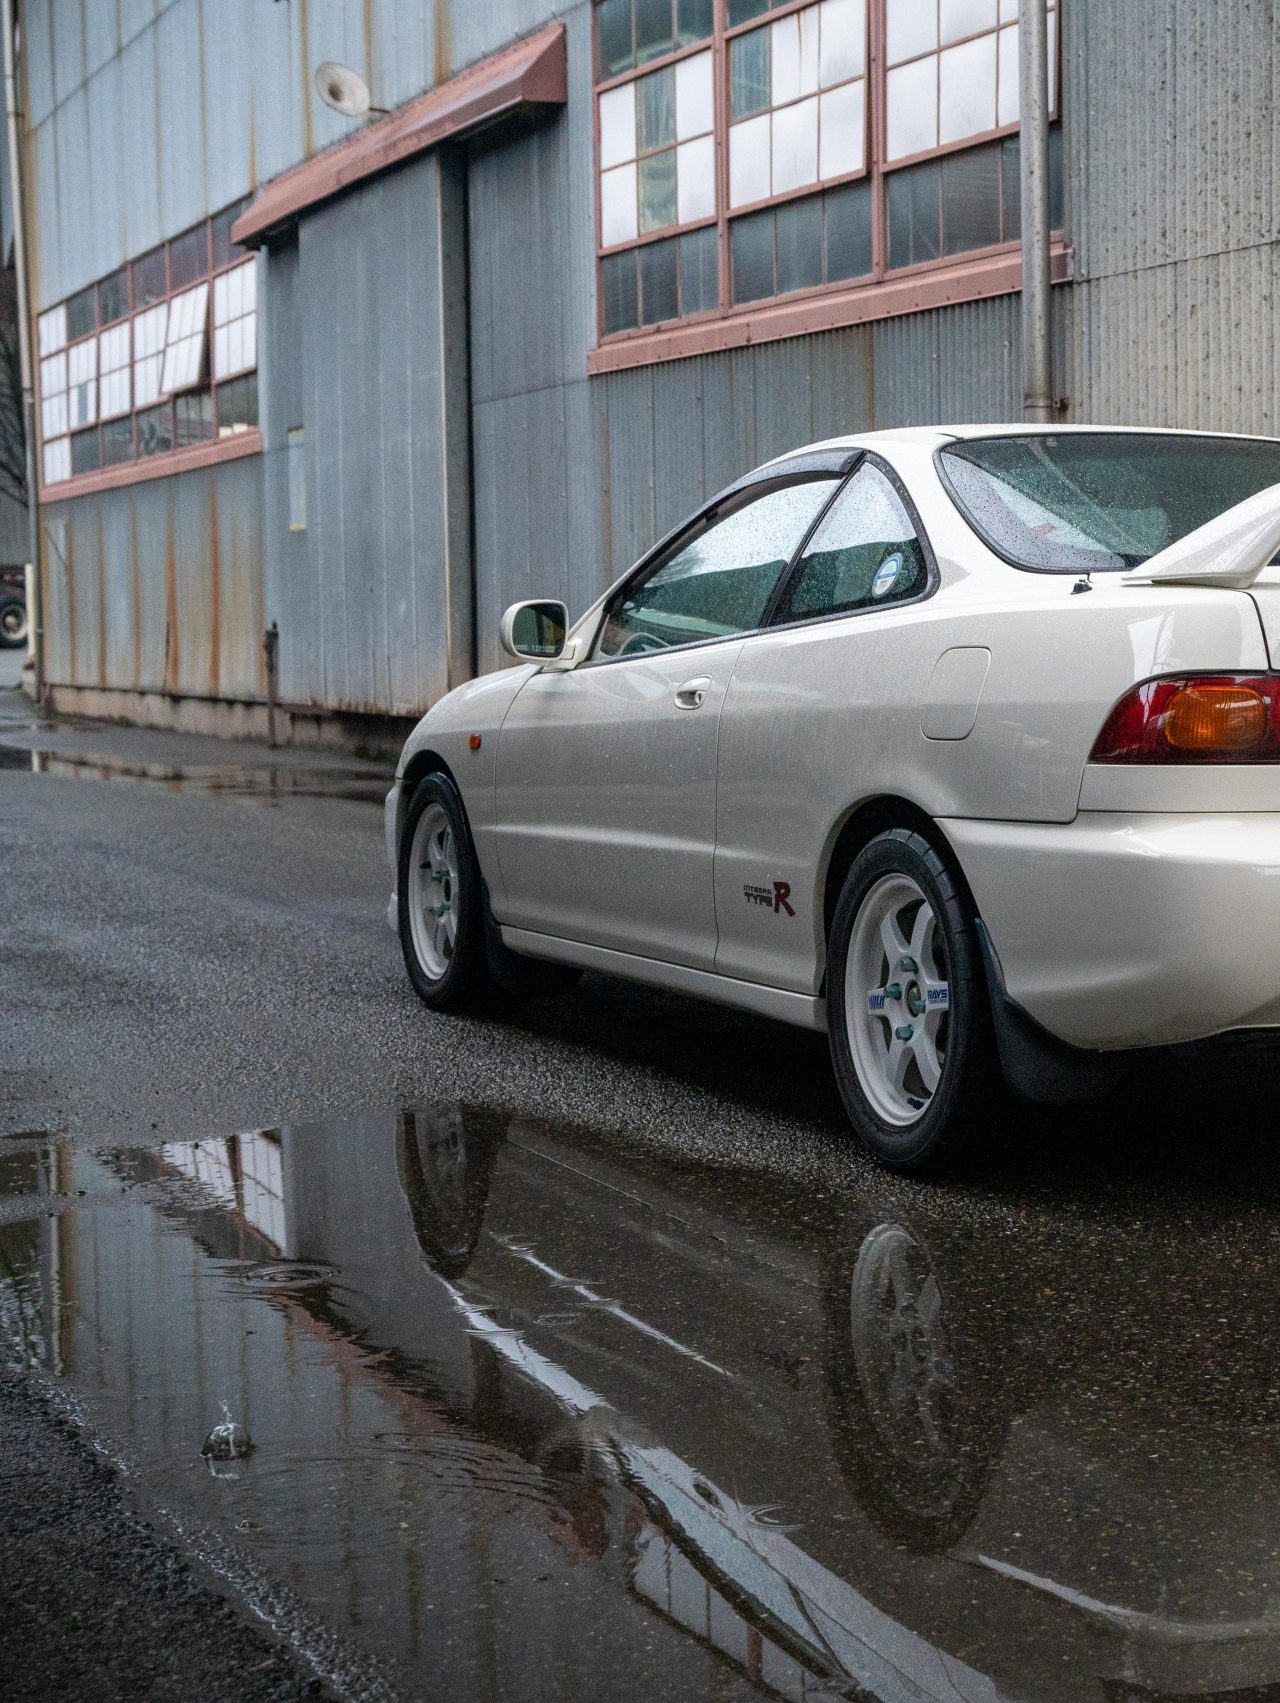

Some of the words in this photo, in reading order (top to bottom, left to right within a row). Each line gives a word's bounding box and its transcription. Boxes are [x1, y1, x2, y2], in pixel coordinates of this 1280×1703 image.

[743, 892, 773, 907] TYPE
[773, 881, 796, 917] R
[927, 988, 948, 999] RAYS
